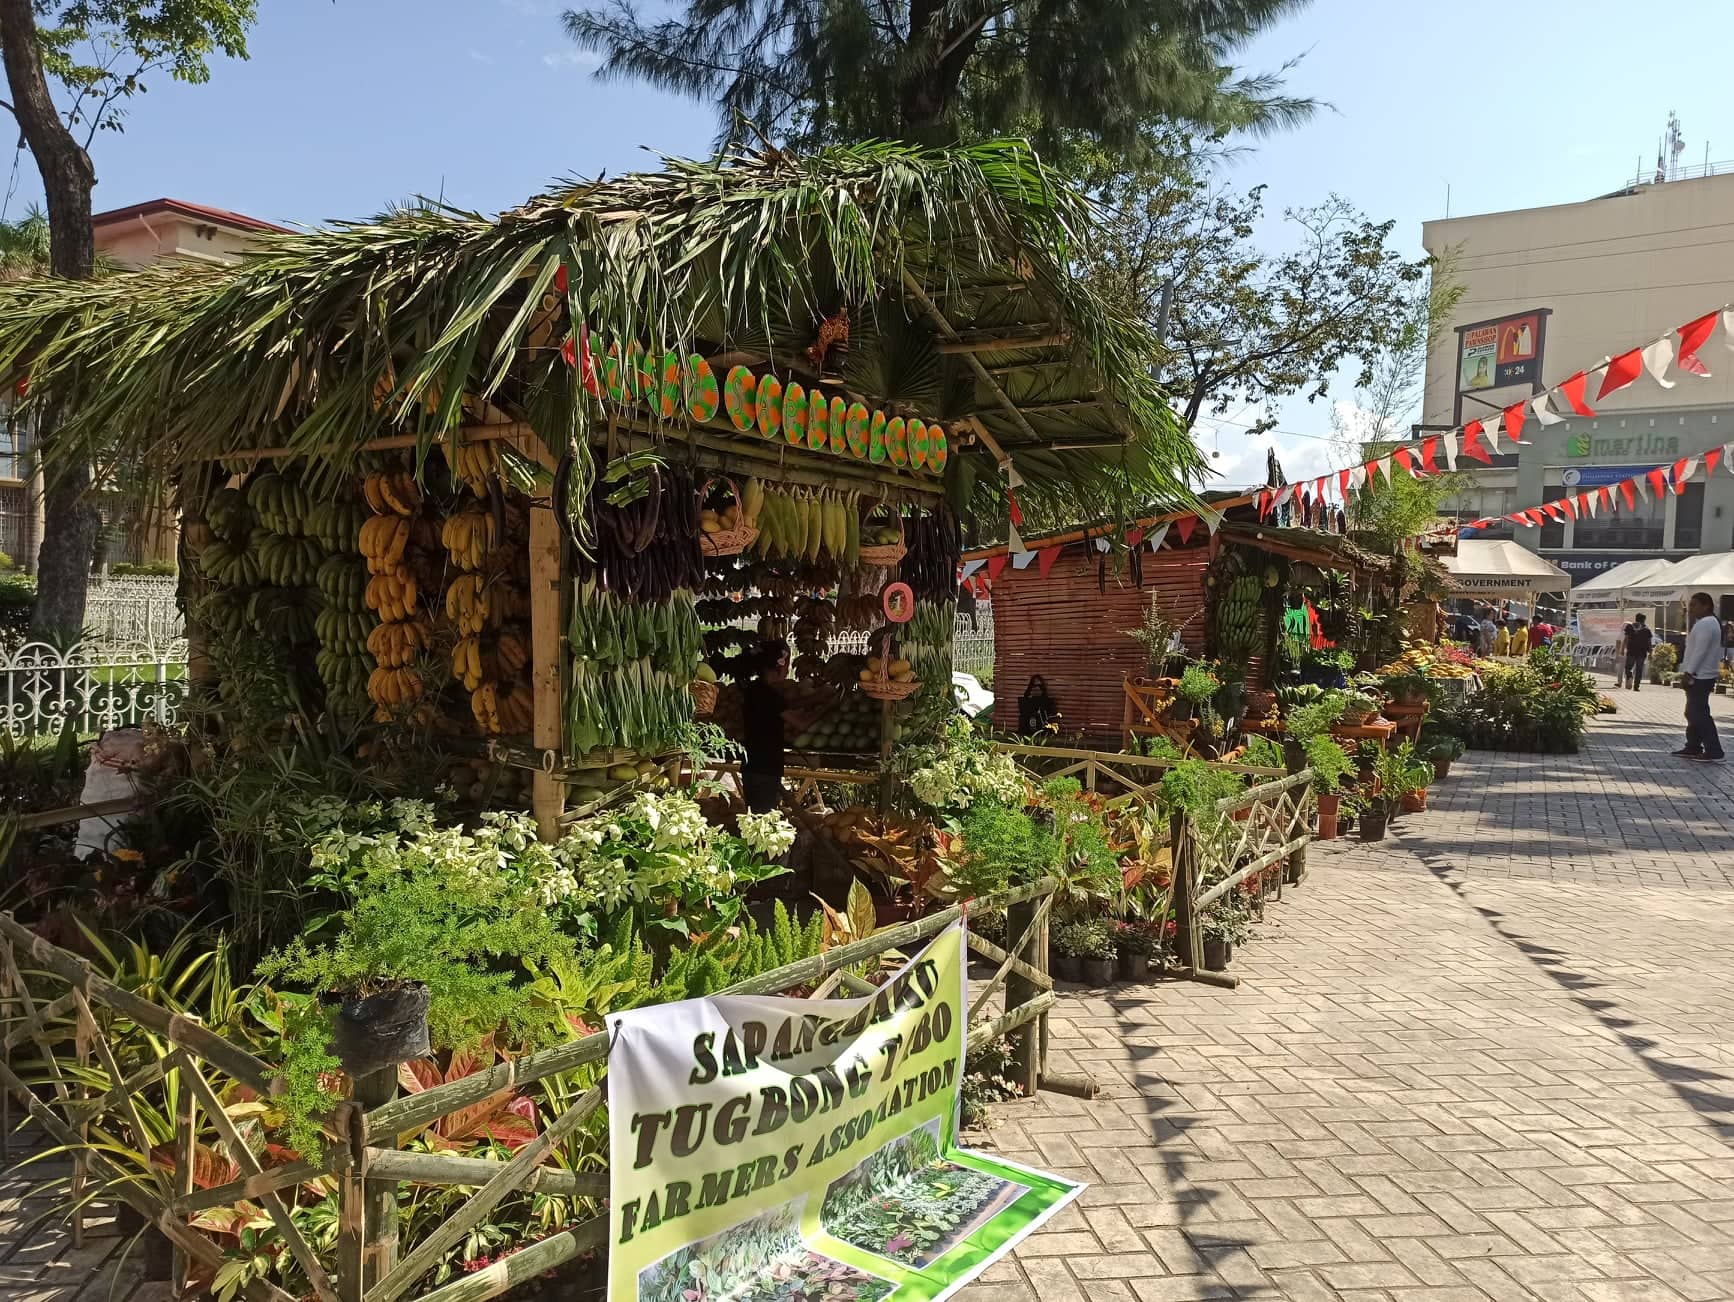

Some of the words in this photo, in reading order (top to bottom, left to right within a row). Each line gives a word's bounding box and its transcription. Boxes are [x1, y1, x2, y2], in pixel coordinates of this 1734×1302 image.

[1561, 561, 1592, 570] Bank
[880, 1001, 952, 1082] TBO
[617, 1143, 805, 1245] FARMERS
[806, 1057, 957, 1168] ASSOIATION
